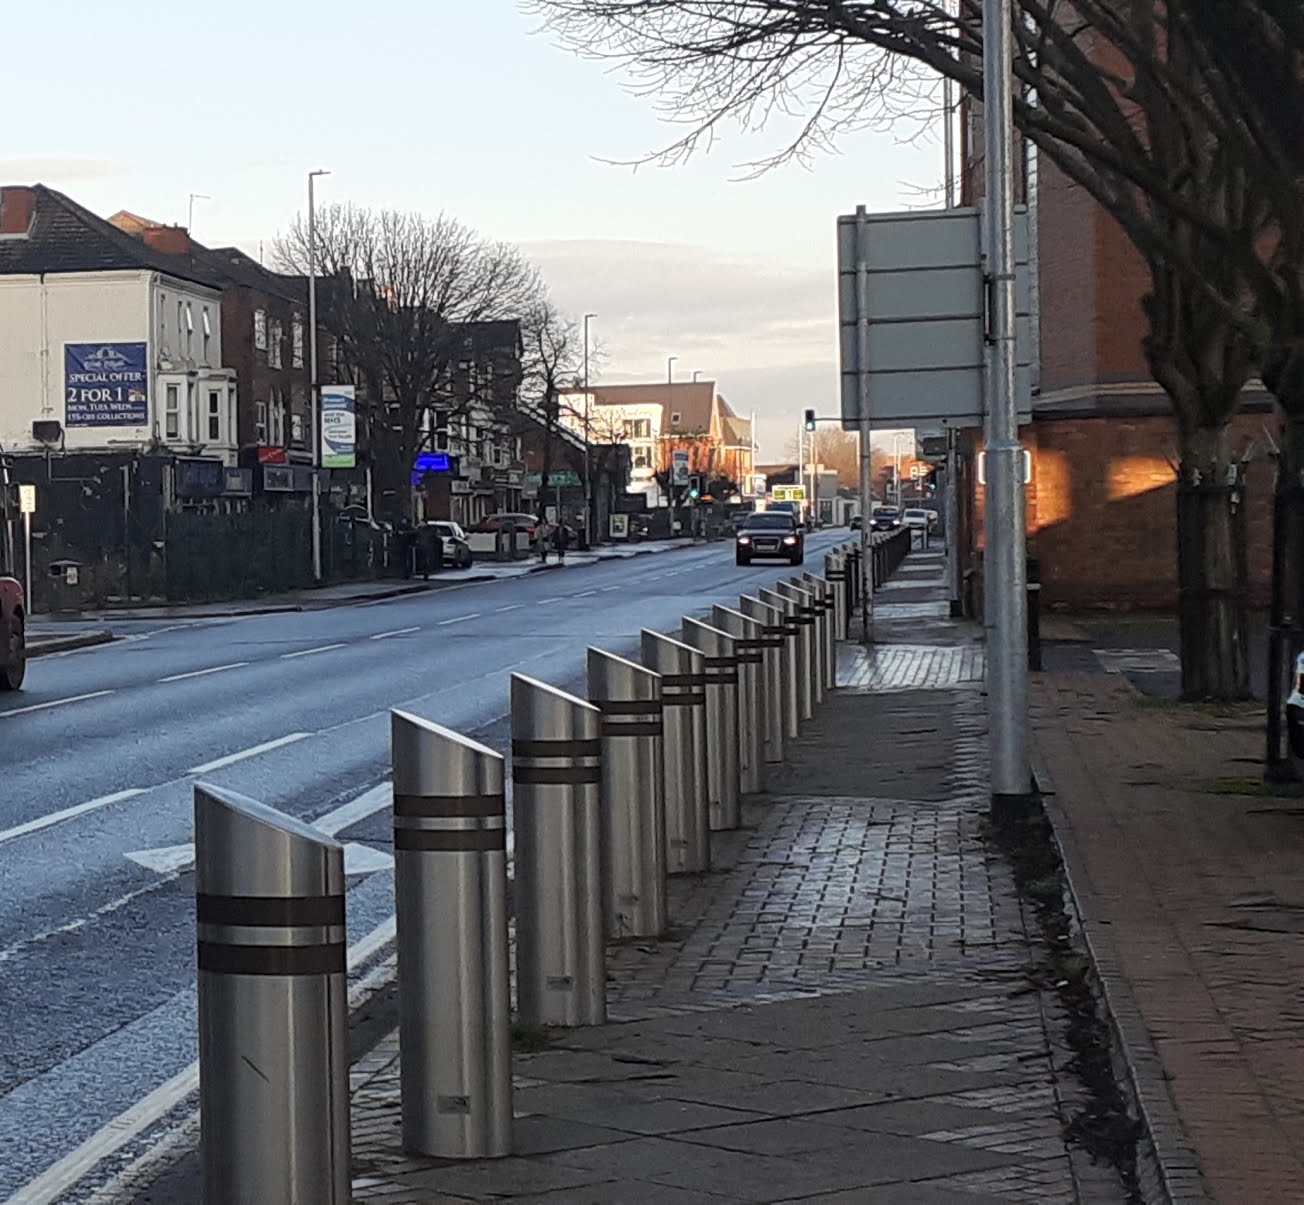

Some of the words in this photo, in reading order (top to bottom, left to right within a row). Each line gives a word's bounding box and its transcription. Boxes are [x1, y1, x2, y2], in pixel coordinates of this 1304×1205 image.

[69, 373, 108, 383] SPECIAL
[109, 371, 142, 382] OFFER
[67, 387, 78, 402] 2
[81, 388, 113, 402] FOR
[115, 386, 123, 402] 1
